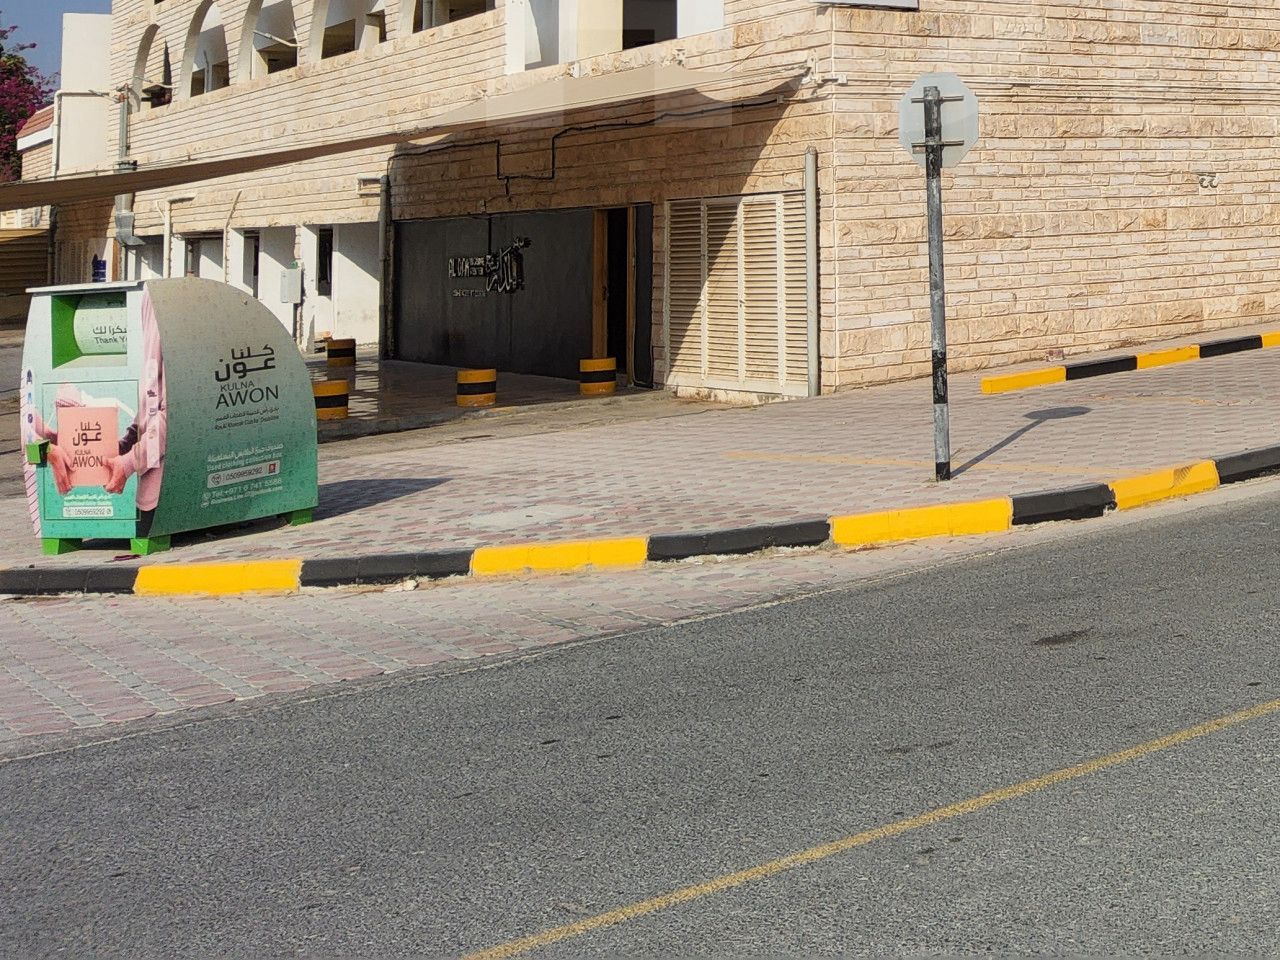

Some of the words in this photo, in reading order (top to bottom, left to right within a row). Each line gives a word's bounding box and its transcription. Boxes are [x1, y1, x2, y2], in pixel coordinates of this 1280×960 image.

[231, 343, 275, 360] كلنا
[214, 356, 276, 383] عون
[220, 380, 255, 393] KULNA
[215, 384, 279, 410] AWON
[80, 421, 102, 432] كلنا
[72, 428, 102, 447] عون
[72, 455, 104, 468] AWON
